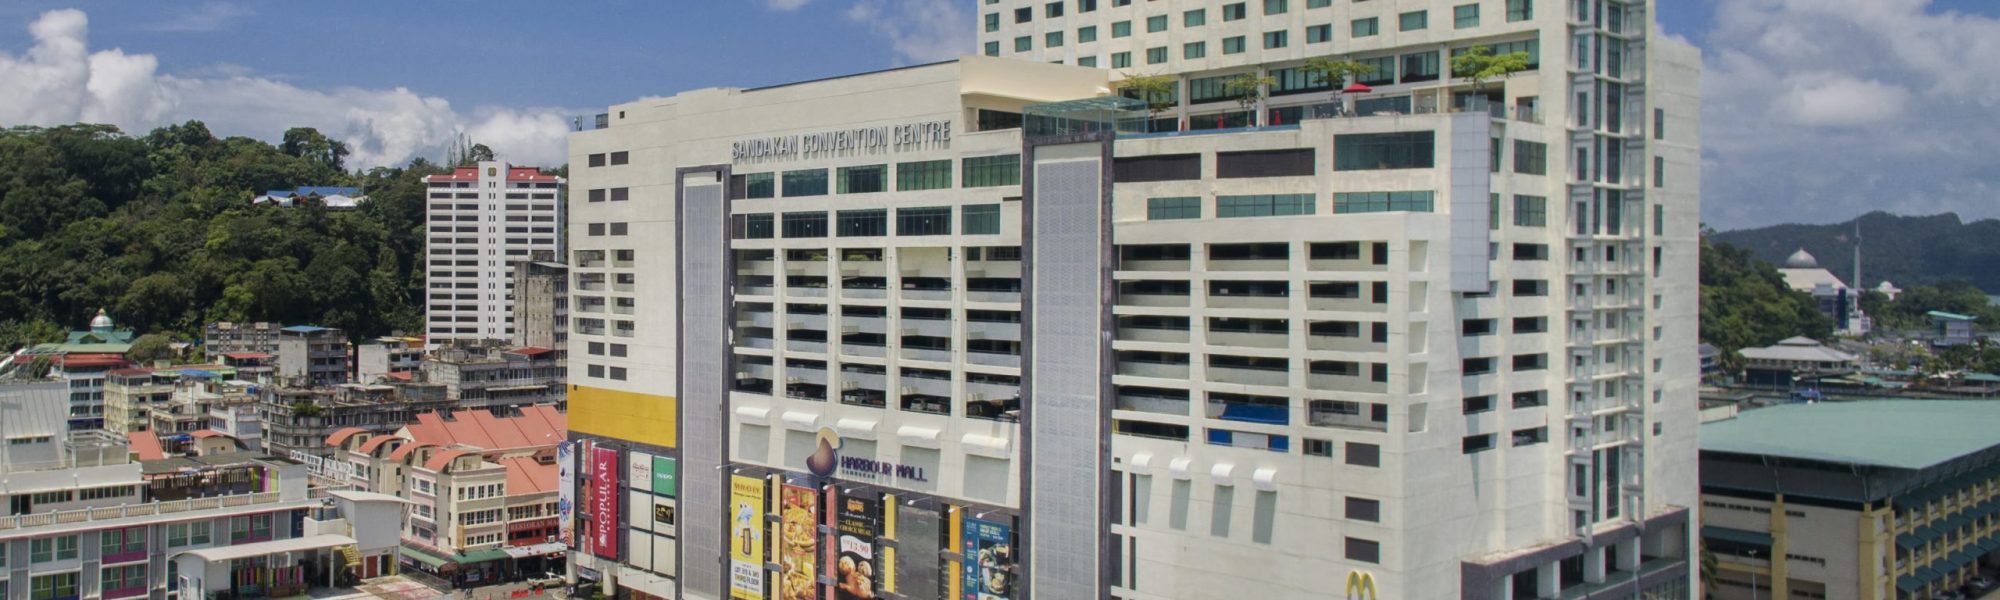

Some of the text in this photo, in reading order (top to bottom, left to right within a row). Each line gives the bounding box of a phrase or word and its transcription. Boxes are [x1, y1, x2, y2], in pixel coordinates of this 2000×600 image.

[732, 119, 951, 159] SANDAKAN CONVENTION CENTRE
[841, 455, 928, 482] HARBOUR MALL
[599, 462, 608, 533] POPULAR
